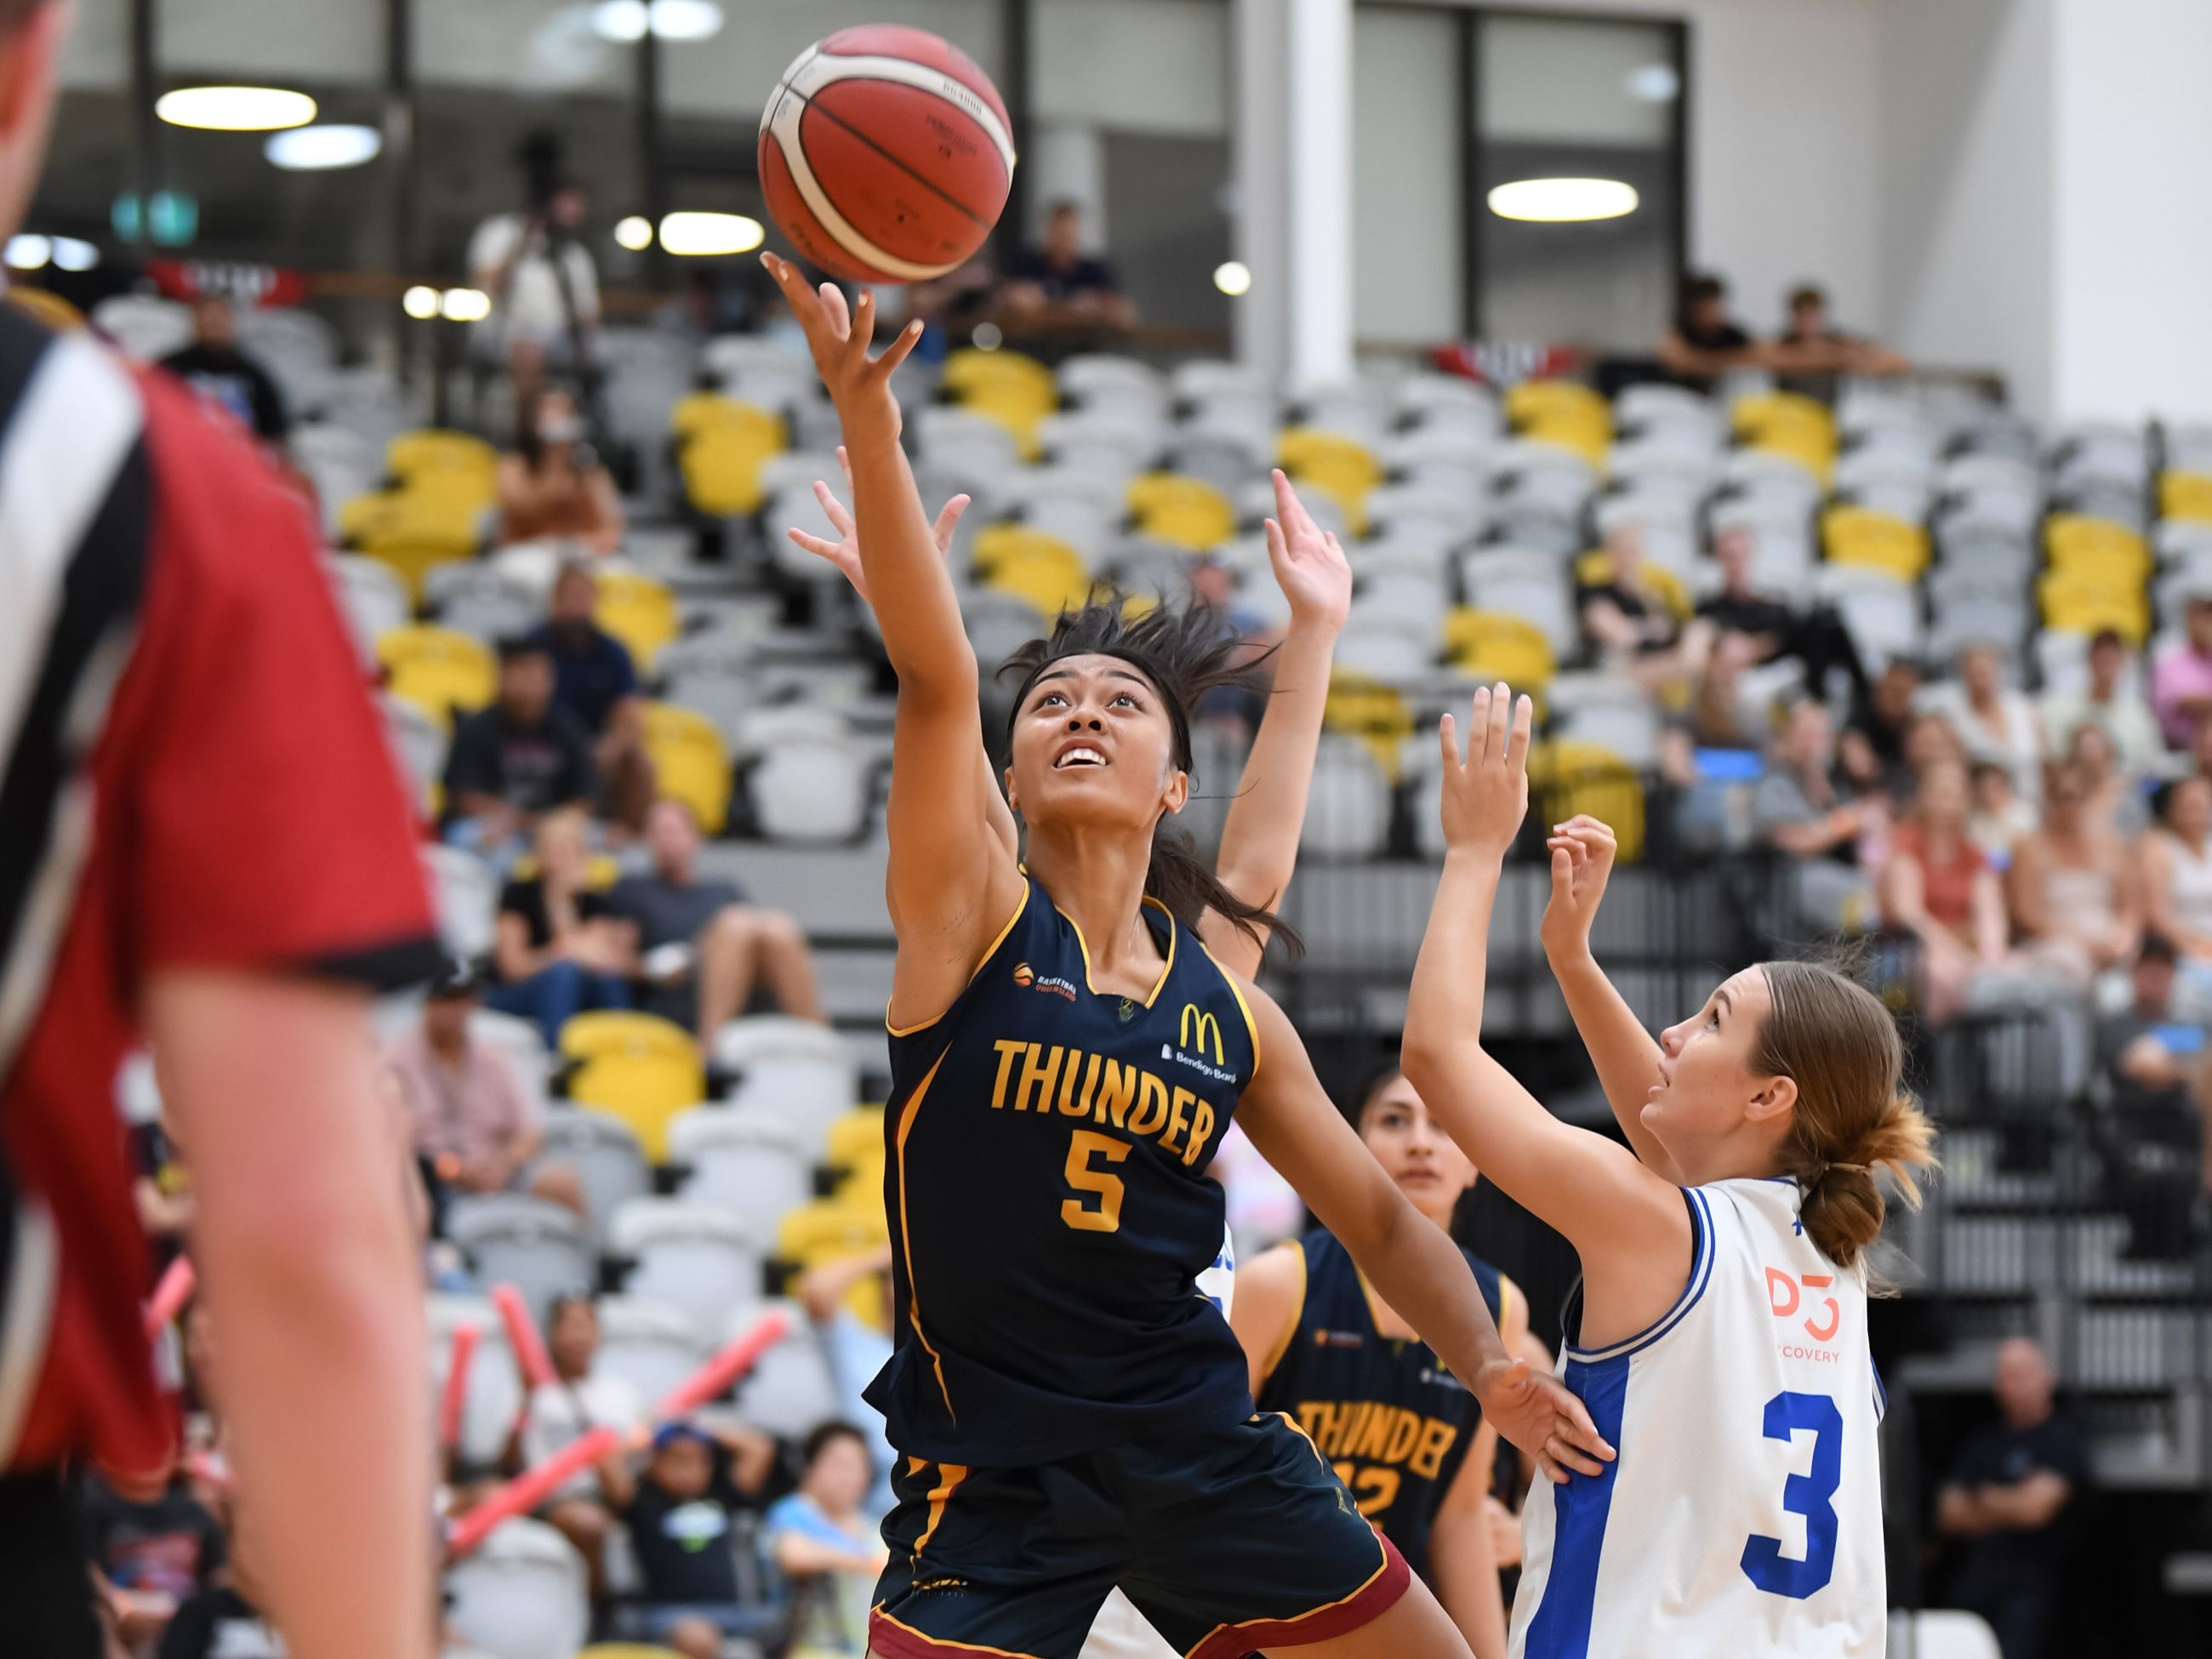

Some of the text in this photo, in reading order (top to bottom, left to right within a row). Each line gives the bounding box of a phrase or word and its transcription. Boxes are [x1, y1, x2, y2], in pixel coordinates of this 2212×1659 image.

[991, 1040, 1216, 1166] THUNDER
[1177, 1052, 1213, 1076] Bendigo
[1061, 1129, 1133, 1233] 5
[1777, 1343, 1840, 1364] COVERY
[1740, 1390, 1844, 1599] 3
